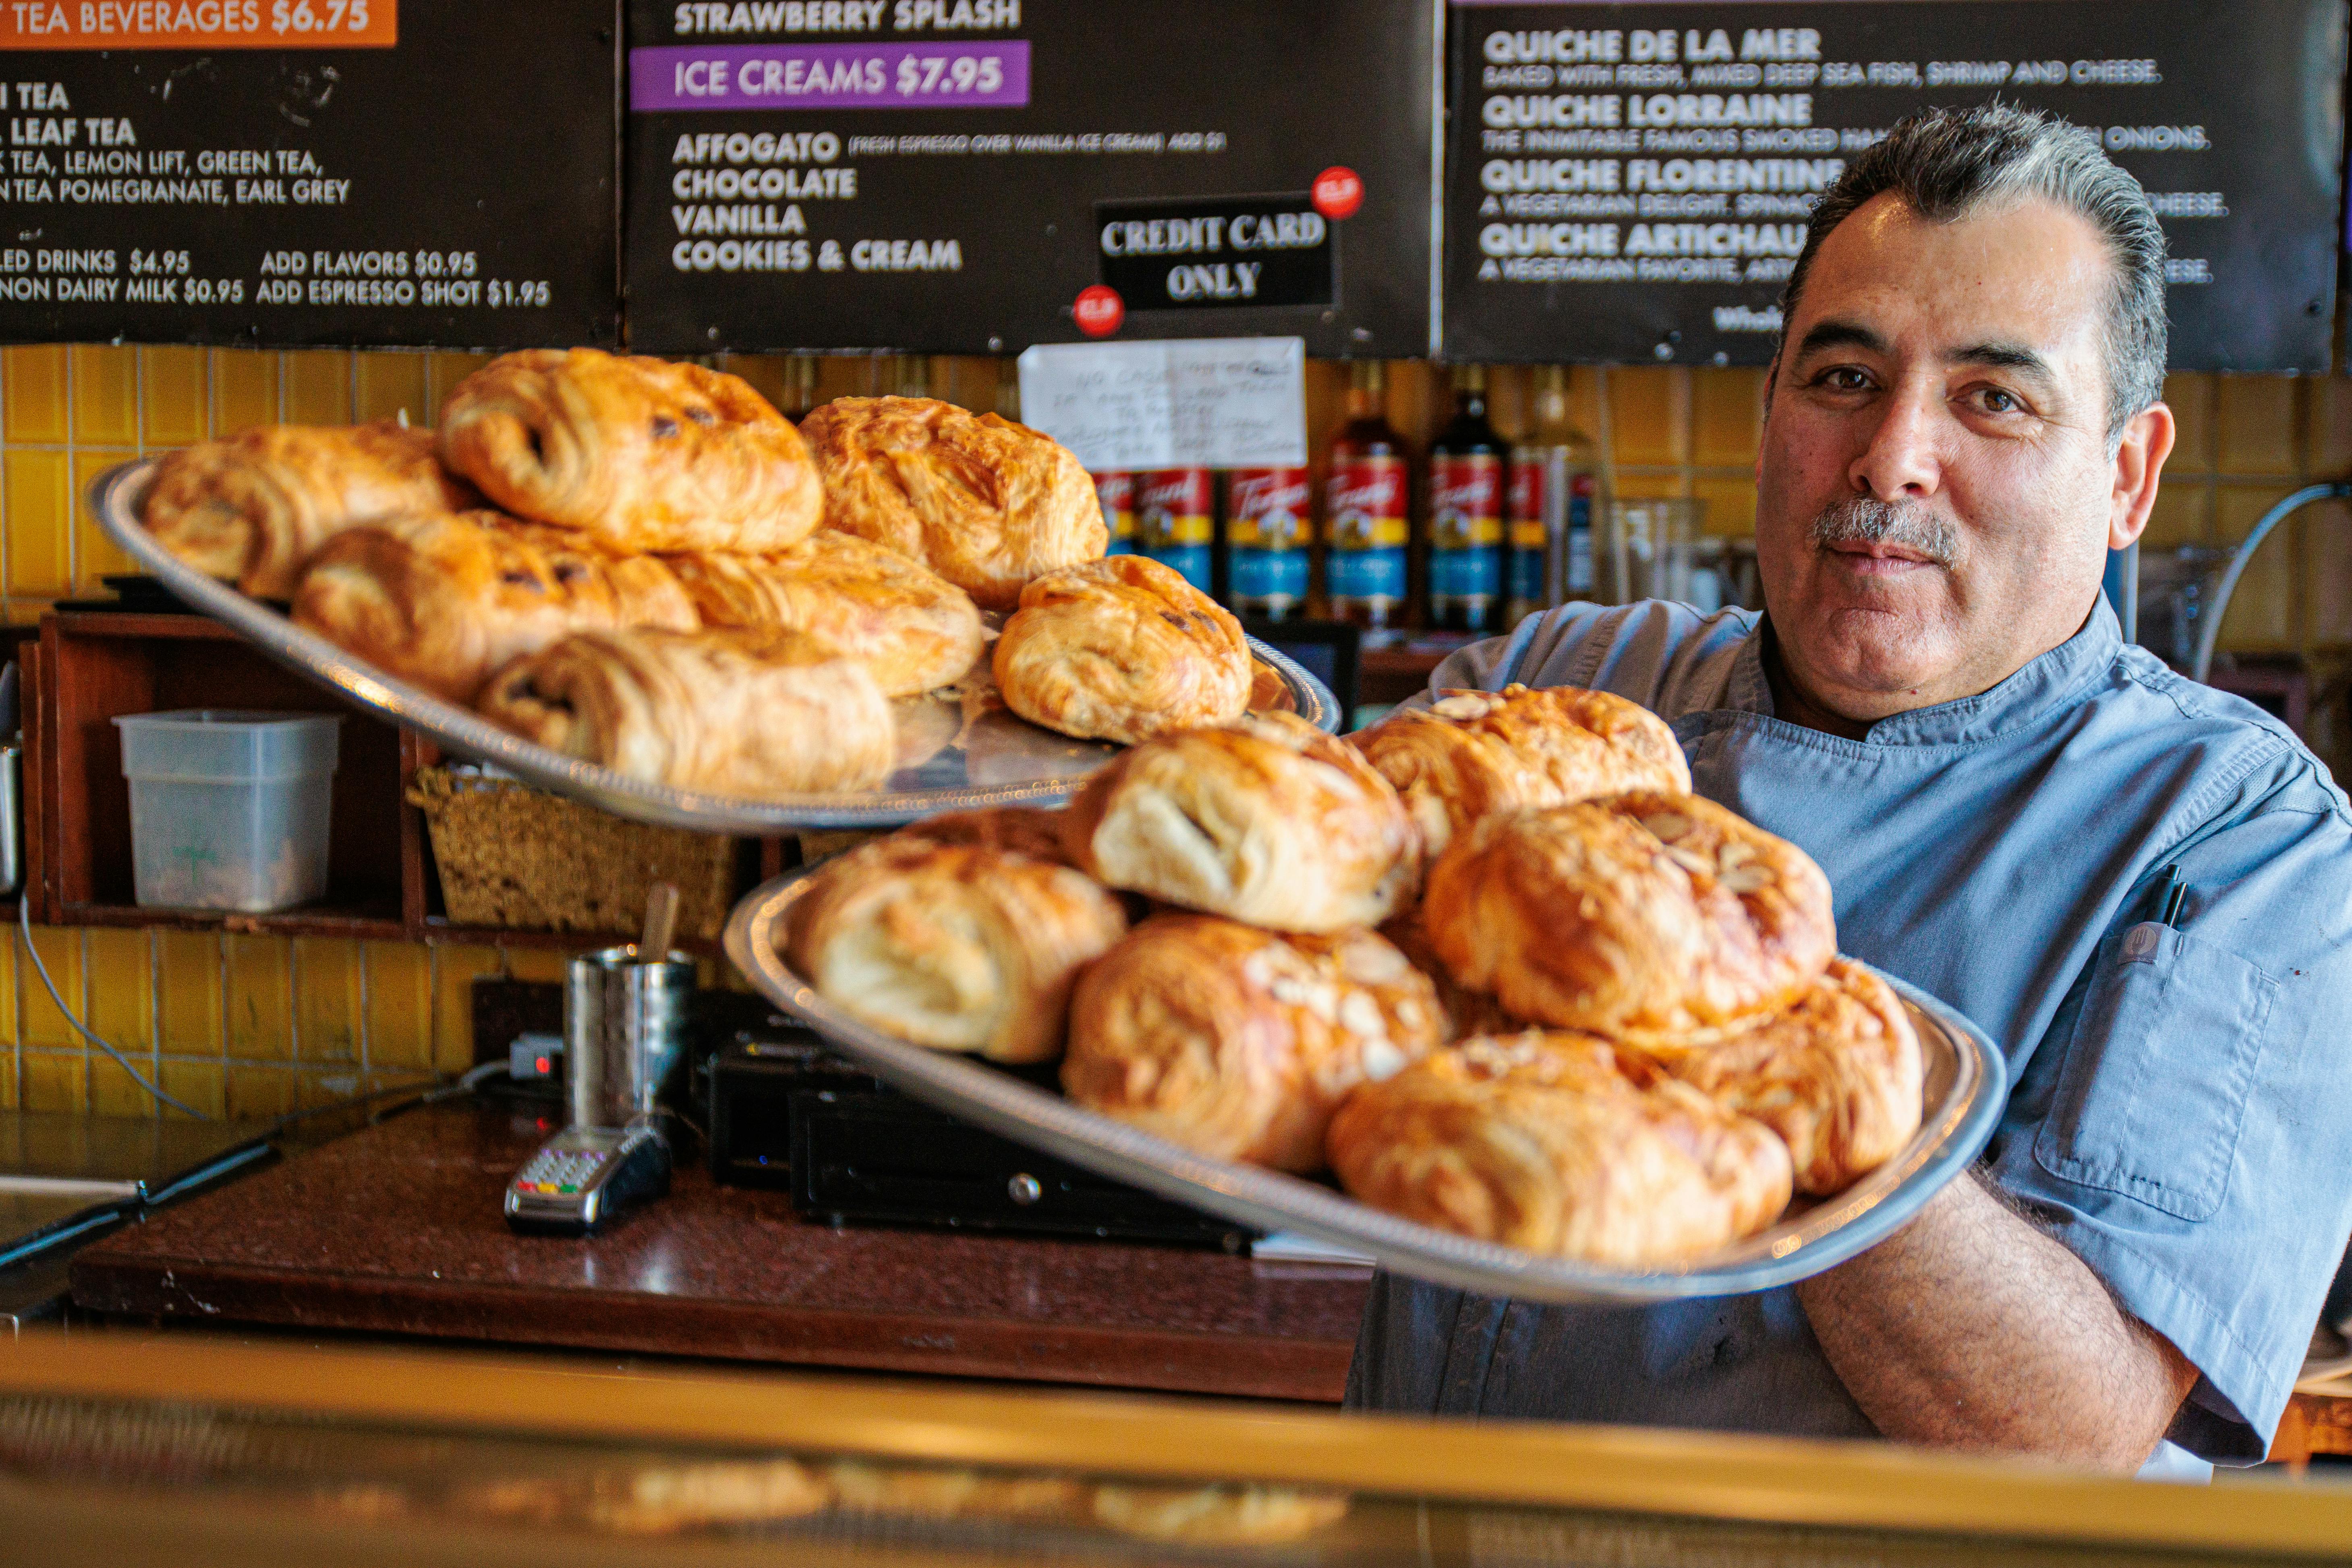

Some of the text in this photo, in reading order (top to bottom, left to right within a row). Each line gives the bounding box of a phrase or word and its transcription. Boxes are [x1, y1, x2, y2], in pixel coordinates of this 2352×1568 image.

[12, 0, 368, 35] TEA BEVERAGES $6.75
[675, 0, 1019, 32] STRAWBERRY SPLASH
[1484, 29, 1820, 62] QUICHE DE LA MER
[675, 54, 1003, 96] ICE CREAMS $7.95
[17, 83, 69, 109] TEA
[1483, 94, 1813, 127] QUICHE LORRAINE
[12, 118, 136, 145] LEAF TEA
[673, 132, 839, 162] AFFOGATO
[10, 151, 56, 176] TEA,
[65, 151, 142, 174] LEMON
[149, 151, 190, 177] LIFT,
[197, 151, 270, 174] GREEN
[276, 151, 322, 177] TEA,
[1482, 159, 1620, 192] QUICHE
[13, 179, 53, 201] TEA
[60, 180, 228, 205] POMEGRANATE,
[236, 180, 286, 203] EARL
[292, 180, 349, 203] GREY
[673, 169, 855, 198] CHOCOLATE
[672, 205, 804, 233] VANILLA
[1101, 212, 1325, 254] CREDIT CARD
[1480, 223, 1619, 256] QUICHE
[0, 249, 189, 274] ED DRINKS $4.95
[260, 250, 476, 278] ADD FLAVORS $0.95
[672, 240, 960, 269] COOKIES & CREAM
[0, 277, 243, 304] NON DAIRY MILK $0.95
[256, 279, 549, 307] ADD ESPRESSO SHOT $1.95
[1167, 263, 1258, 298] ONLY
